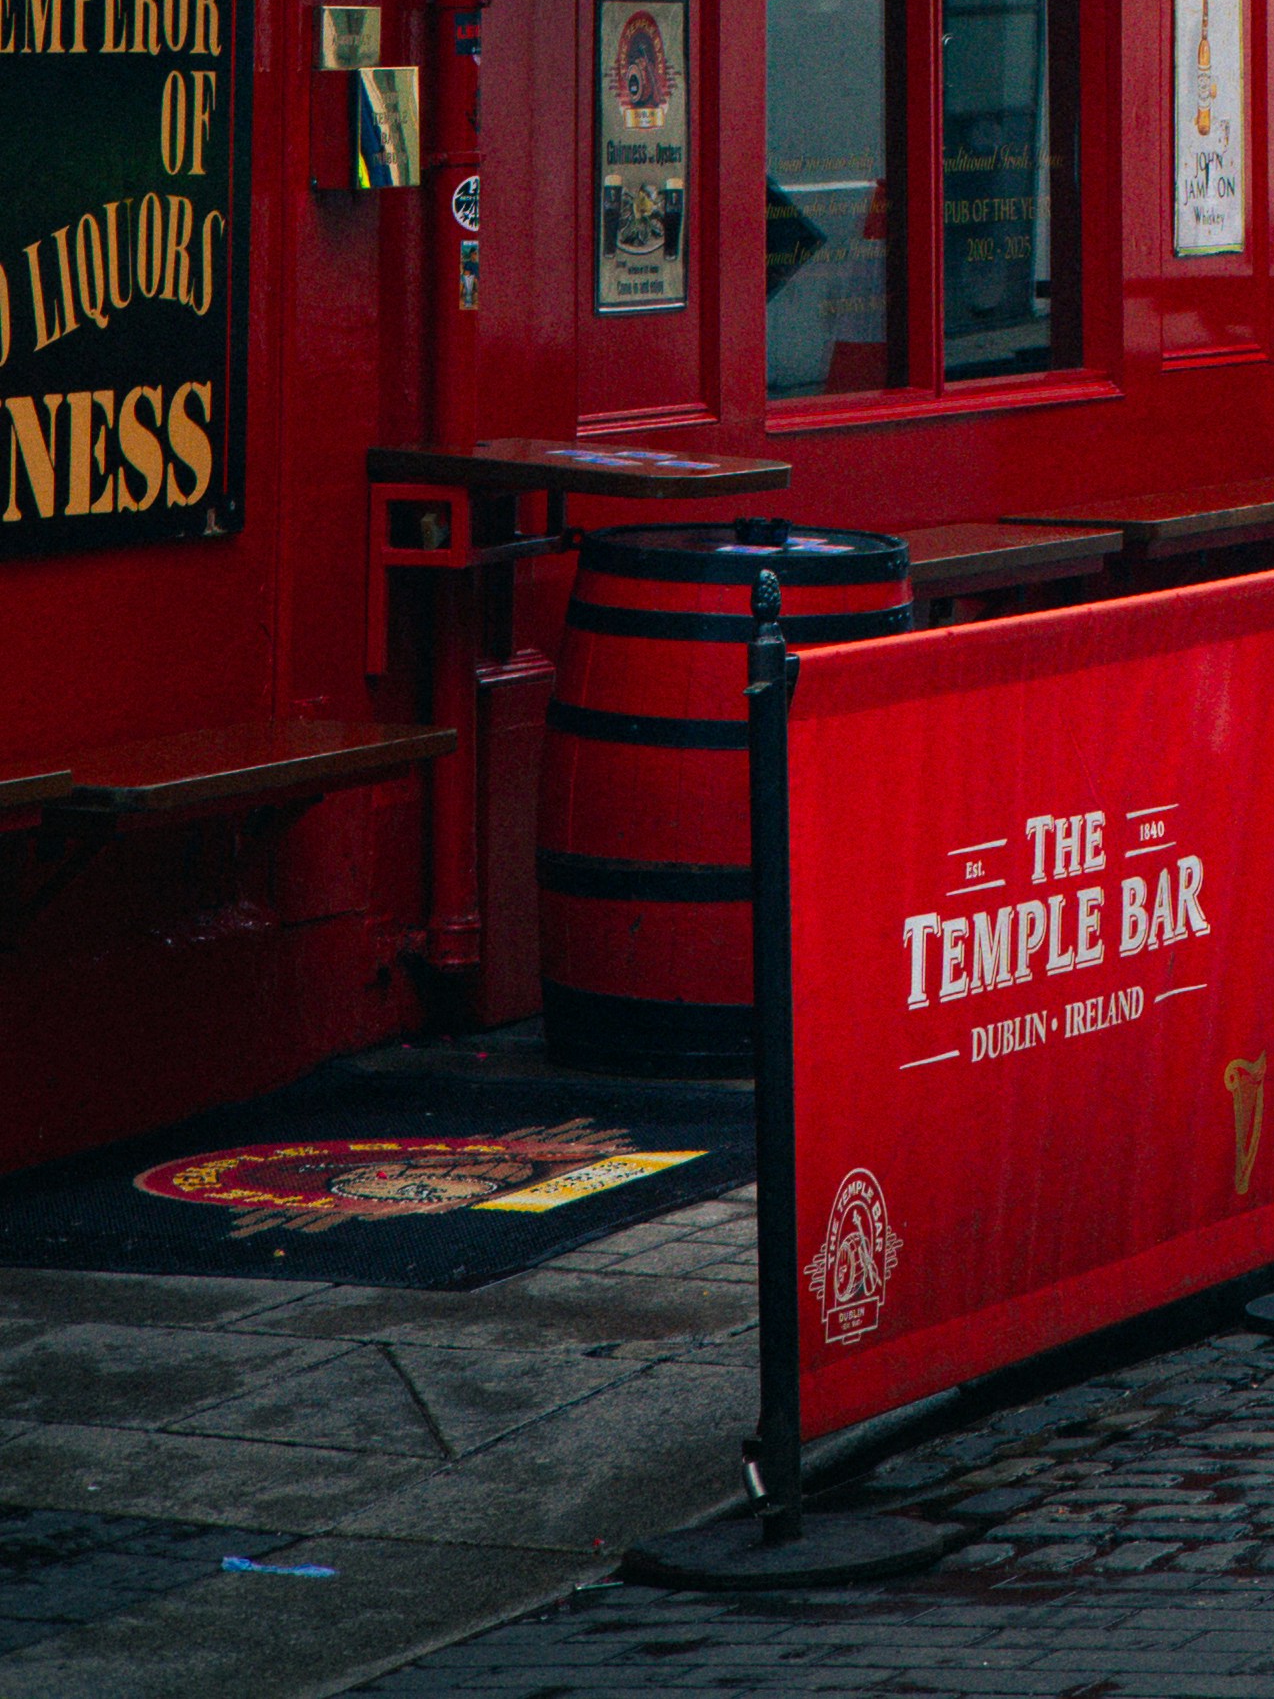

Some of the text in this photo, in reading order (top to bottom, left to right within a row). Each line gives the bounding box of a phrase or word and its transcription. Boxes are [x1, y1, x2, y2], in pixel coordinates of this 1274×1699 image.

[160, 69, 217, 177] OF
[1183, 176, 1236, 207] JAMON
[1194, 152, 1225, 180] JOHN
[23, 192, 226, 354] LIQUORS
[2, 380, 214, 521] NESS
[965, 810, 1166, 885] Est. THE 1840
[902, 853, 1211, 1011] TEMPLE BAR
[971, 985, 1144, 1063] DUBLIN IRELAND
[827, 1180, 883, 1270] THE TEMPLE BAR
[839, 1308, 866, 1323] DUBLIN
